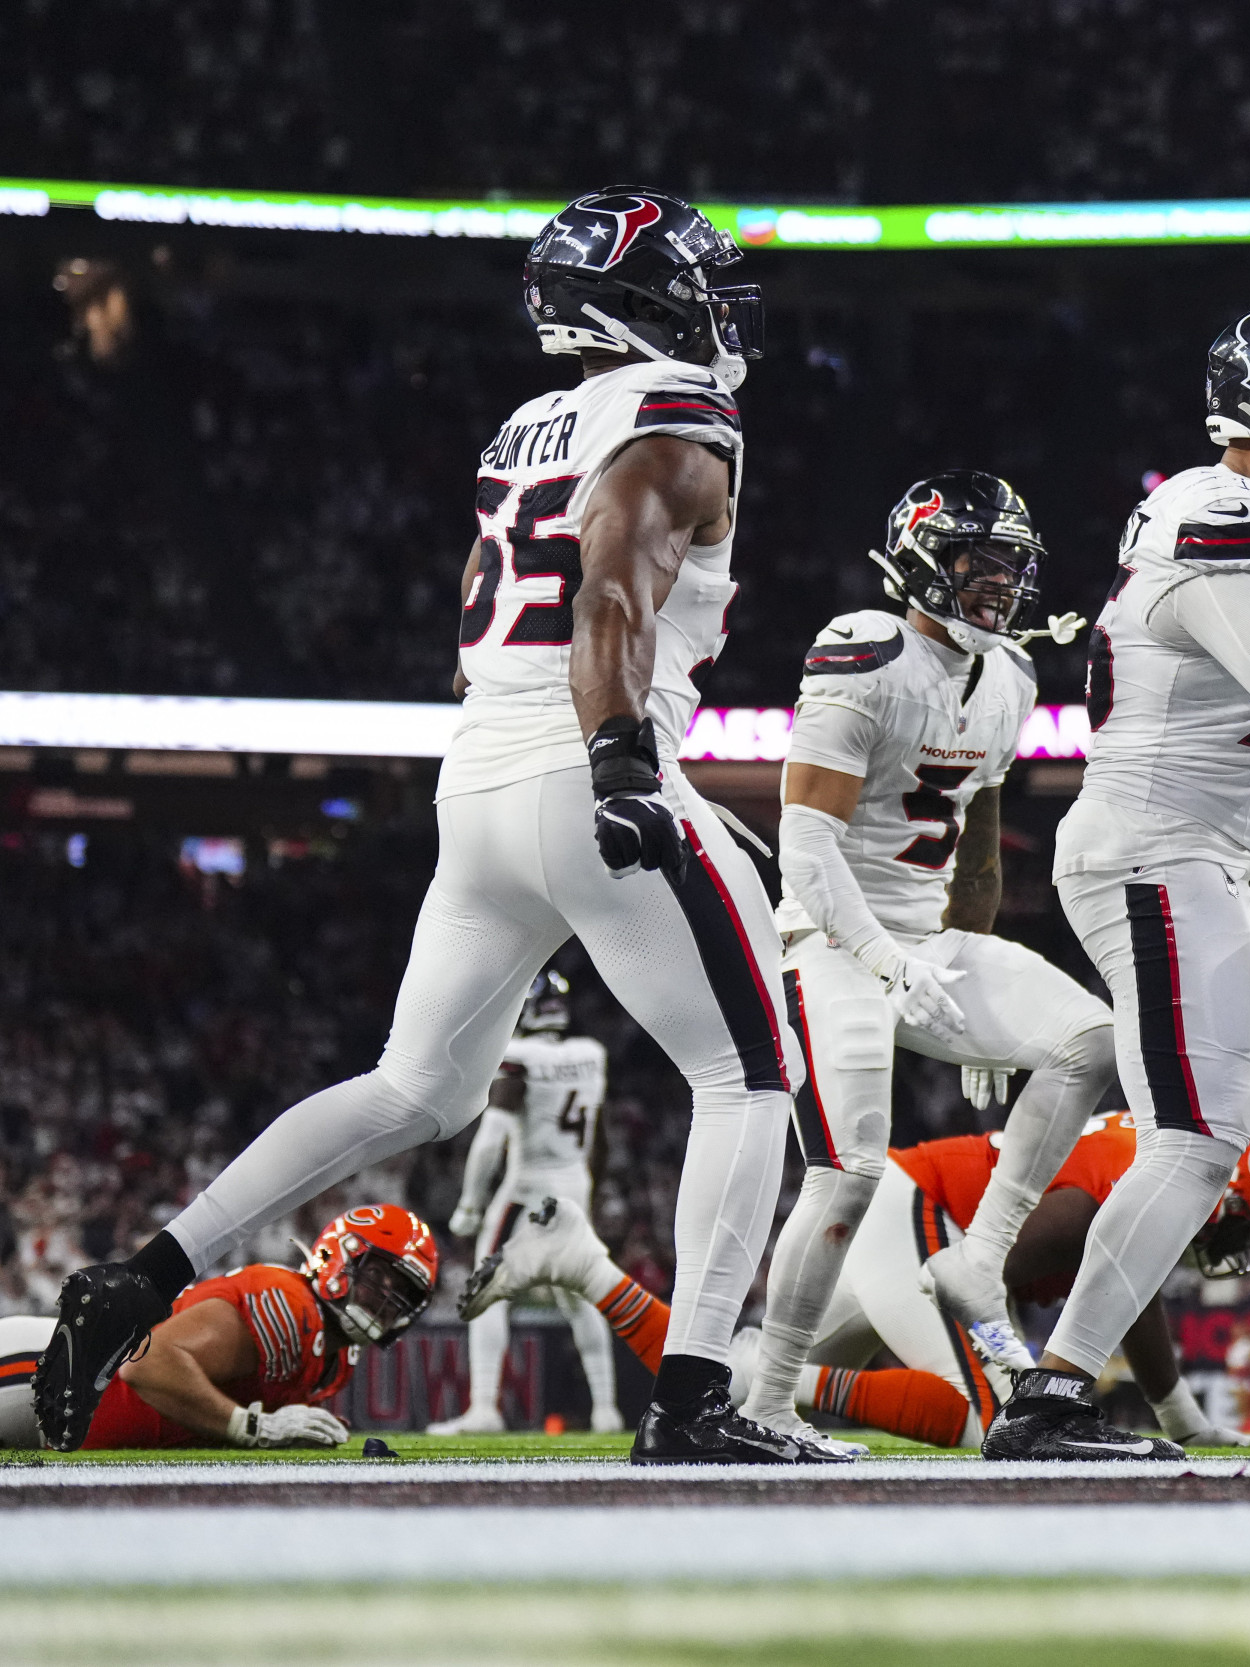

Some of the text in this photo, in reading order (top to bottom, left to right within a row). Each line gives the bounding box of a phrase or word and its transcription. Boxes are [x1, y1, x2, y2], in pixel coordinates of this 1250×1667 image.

[920, 744, 986, 760] HOUSTON
[893, 763, 978, 870] 5
[558, 1089, 586, 1148] 4
[1043, 1376, 1084, 1399] NIKE
